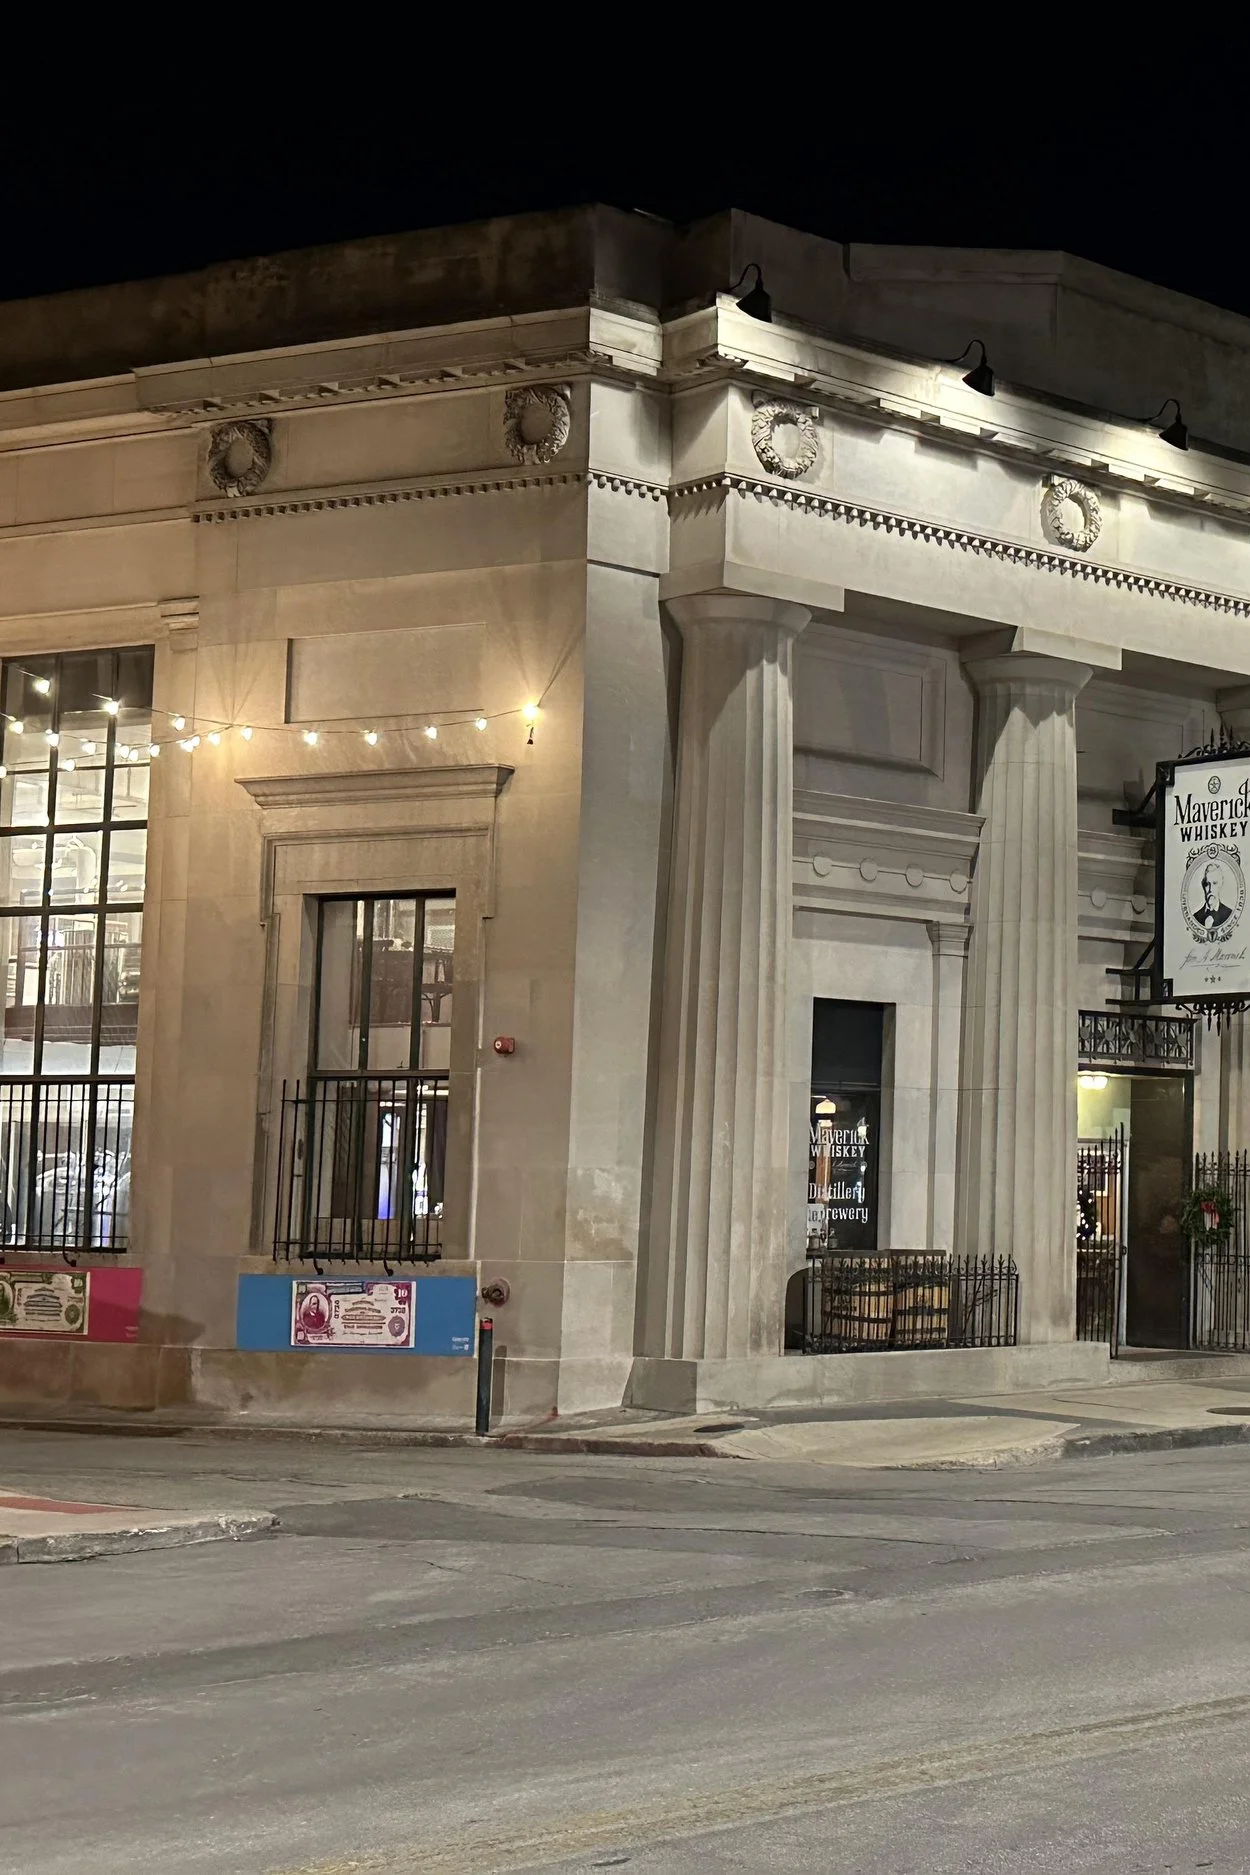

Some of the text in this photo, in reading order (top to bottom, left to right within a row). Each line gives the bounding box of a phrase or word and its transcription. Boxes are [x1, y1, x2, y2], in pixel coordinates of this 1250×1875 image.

[1180, 821, 1248, 842] WHISKEY
[809, 1117, 869, 1145] Maverick
[811, 1145, 866, 1157] WHISKEY
[809, 1181, 866, 1203] Distillery
